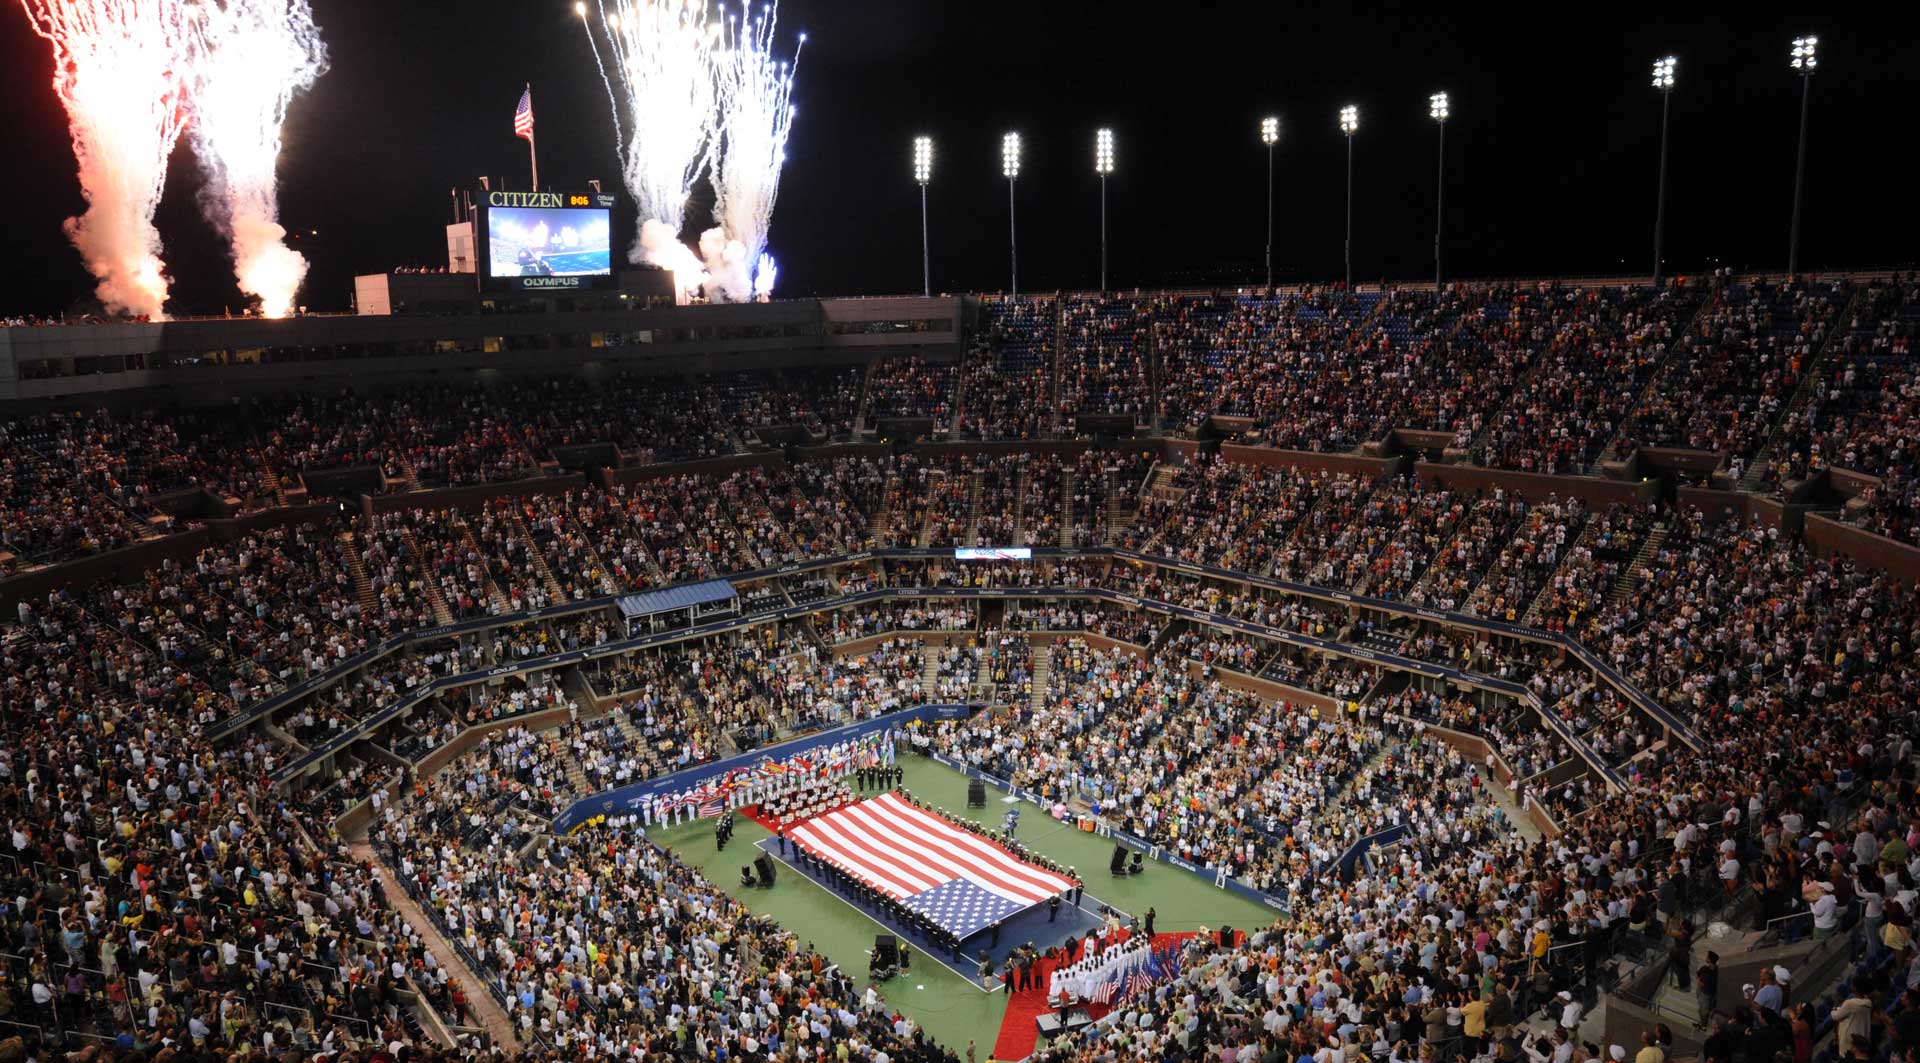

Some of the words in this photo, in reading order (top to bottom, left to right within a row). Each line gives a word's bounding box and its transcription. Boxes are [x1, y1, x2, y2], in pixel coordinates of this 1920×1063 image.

[489, 191, 563, 208] CITIZEN
[523, 277, 579, 287] OLYMPUS
[488, 665, 519, 676] LEXUS
